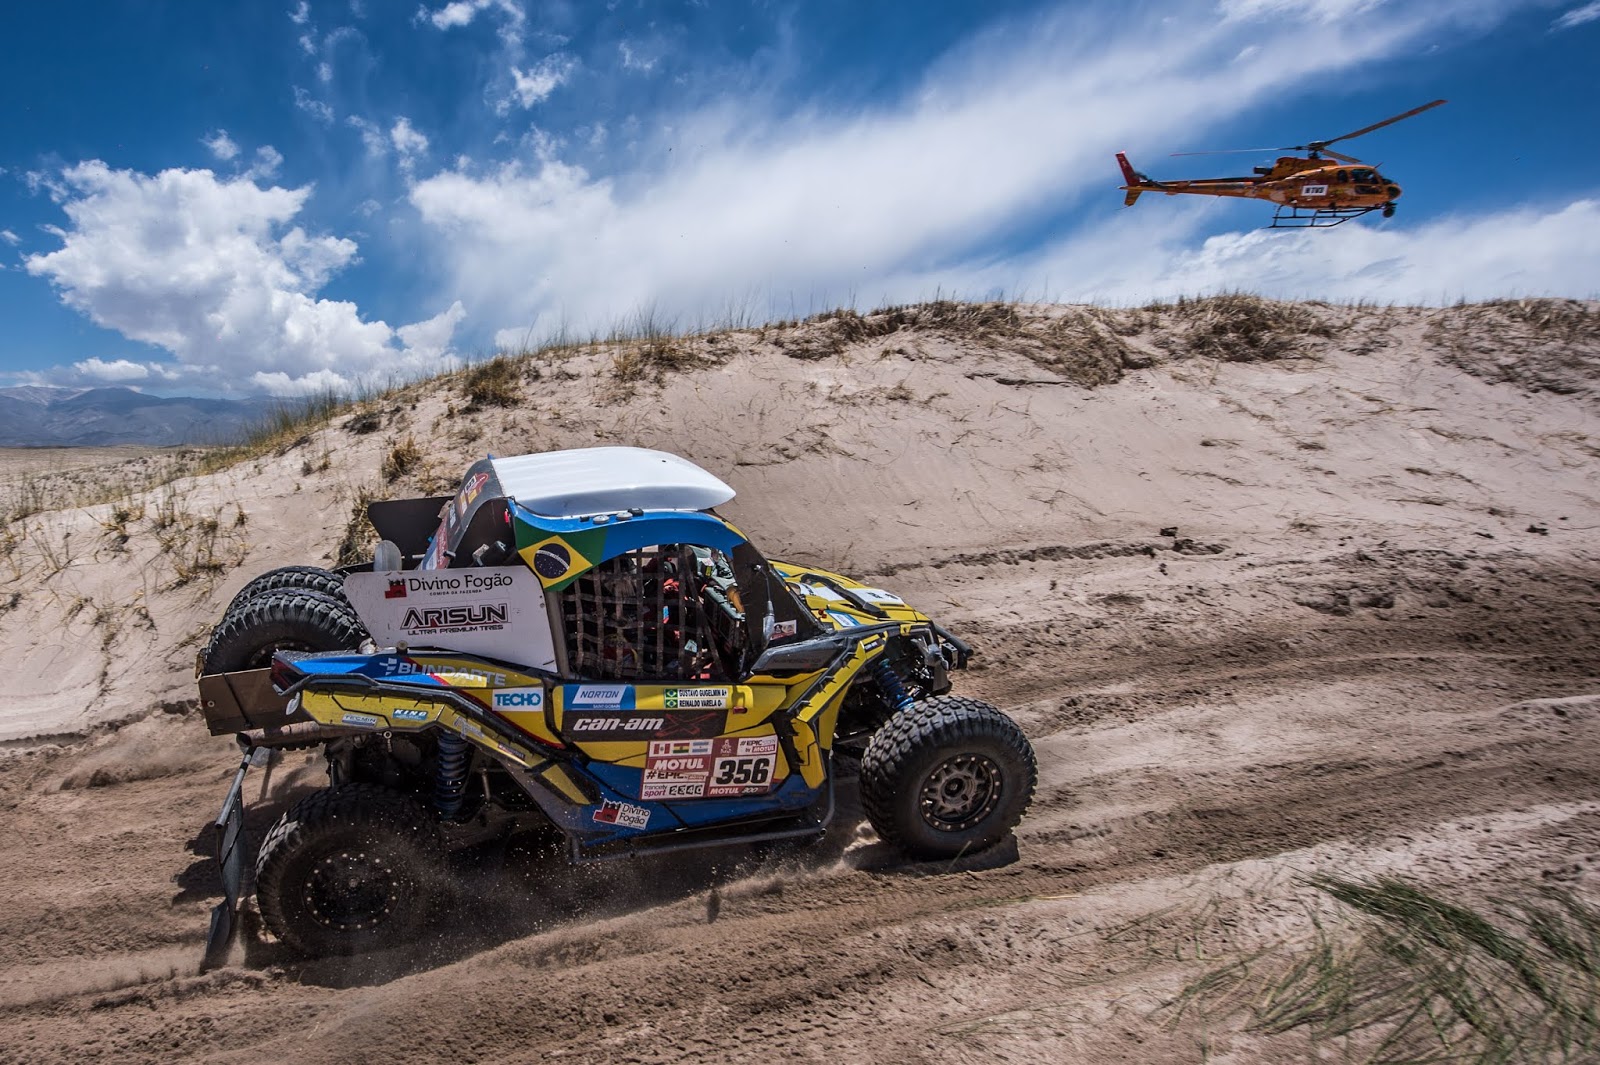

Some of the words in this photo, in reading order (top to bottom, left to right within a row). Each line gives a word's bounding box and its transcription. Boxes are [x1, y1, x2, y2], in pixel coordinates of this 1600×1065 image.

[408, 576, 461, 592] Divino
[464, 573, 513, 591] Fogão
[402, 604, 507, 628] ARISUN
[439, 626, 478, 634] PREMIUM
[397, 662, 506, 687] BLINDARTE
[494, 693, 541, 706] TECHO
[580, 690, 620, 699] NORTON
[678, 689, 699, 697] GUSTAVO
[699, 689, 721, 697] GUGELMIN
[679, 700, 700, 708] REINALDO
[573, 717, 664, 731] can-am
[653, 758, 704, 771] MOTUL
[715, 757, 770, 785] 356
[643, 790, 666, 798] sport
[710, 787, 739, 795] MOTUL
[622, 803, 650, 817] Divino
[619, 812, 646, 825] Fogão
